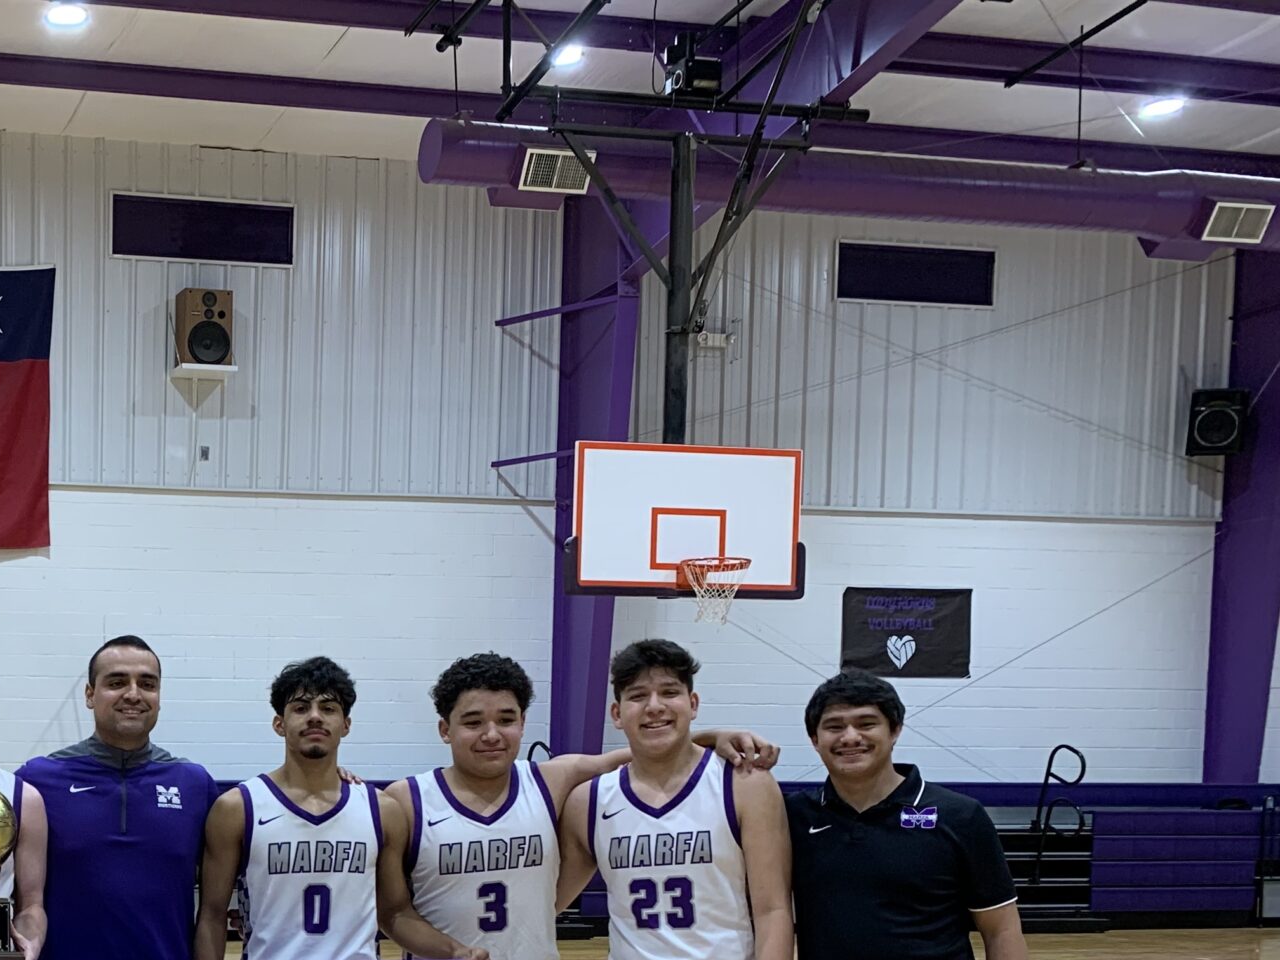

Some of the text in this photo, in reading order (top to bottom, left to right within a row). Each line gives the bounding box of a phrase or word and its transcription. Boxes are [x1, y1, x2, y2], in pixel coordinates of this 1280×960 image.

[868, 618, 934, 630] VOLLEYBALL
[267, 841, 367, 875] MARFA
[438, 834, 543, 875] MARFA
[608, 830, 713, 870] MARFA
[302, 883, 332, 935] 0
[477, 881, 509, 933] 3
[629, 876, 697, 930] 23
